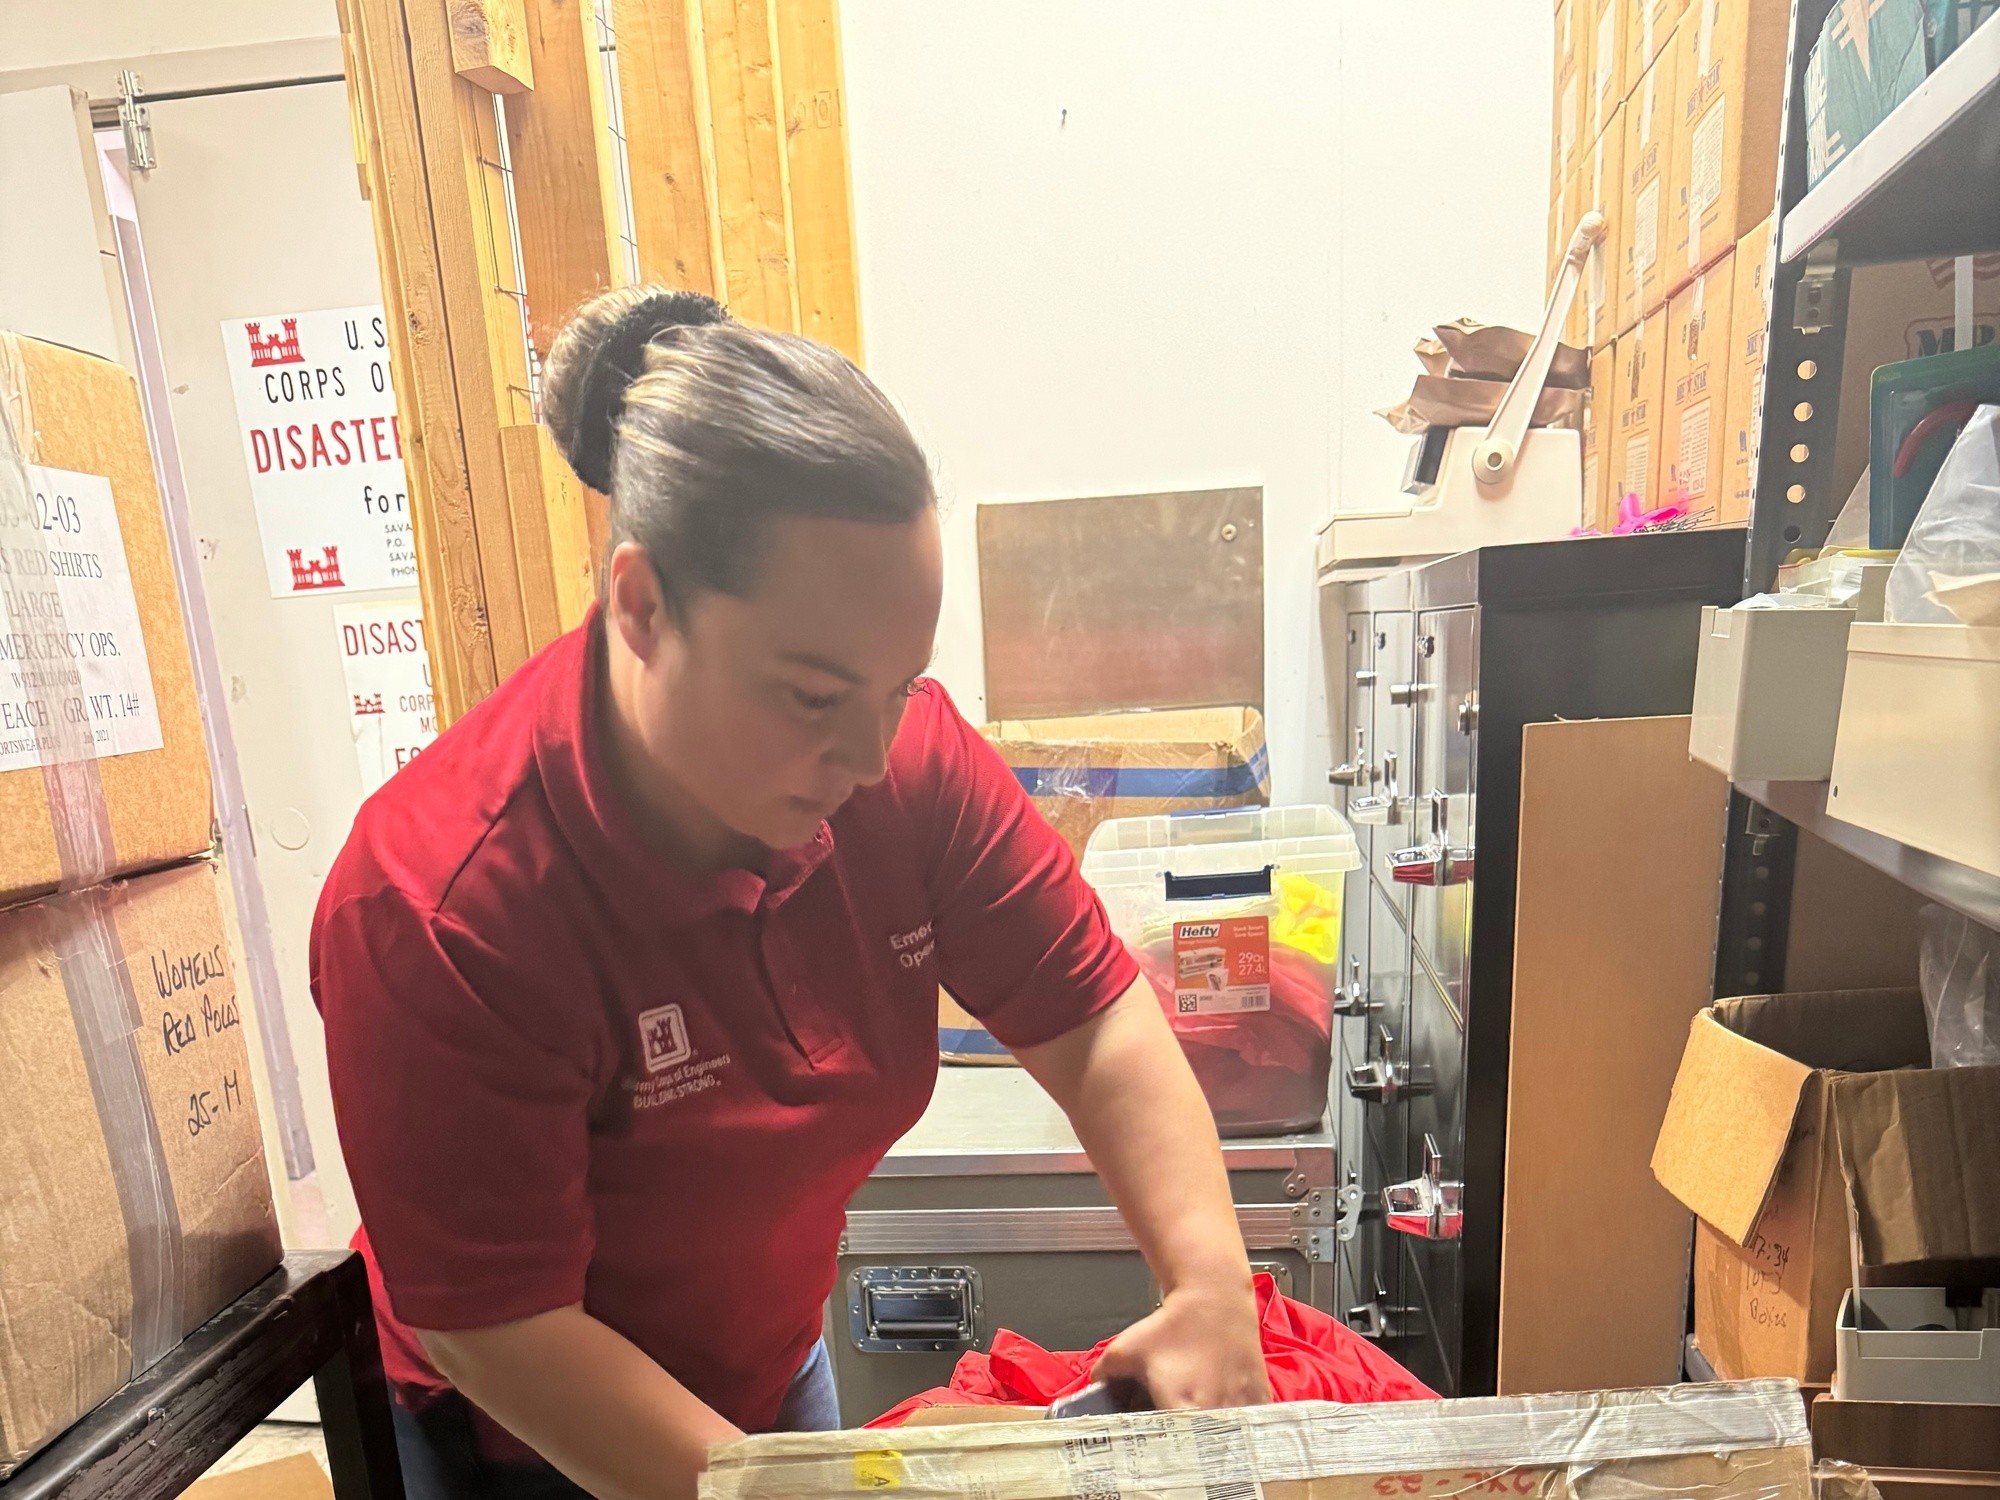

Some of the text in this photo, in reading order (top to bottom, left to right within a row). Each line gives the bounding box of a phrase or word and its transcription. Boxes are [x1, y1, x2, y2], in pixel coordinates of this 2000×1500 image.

[265, 366, 345, 404] CORPS
[364, 485, 405, 514] for
[14, 549, 48, 576] RED
[50, 550, 103, 579] SHIRTS
[5, 591, 63, 618] LARGE
[90, 632, 121, 658] OPS.
[1, 700, 50, 730] EACH
[90, 694, 118, 721] WT.
[119, 692, 140, 718] 14#
[1181, 925, 1218, 937] Hefty
[683, 1053, 731, 1078] Engineers
[874, 1475, 891, 1487] A
